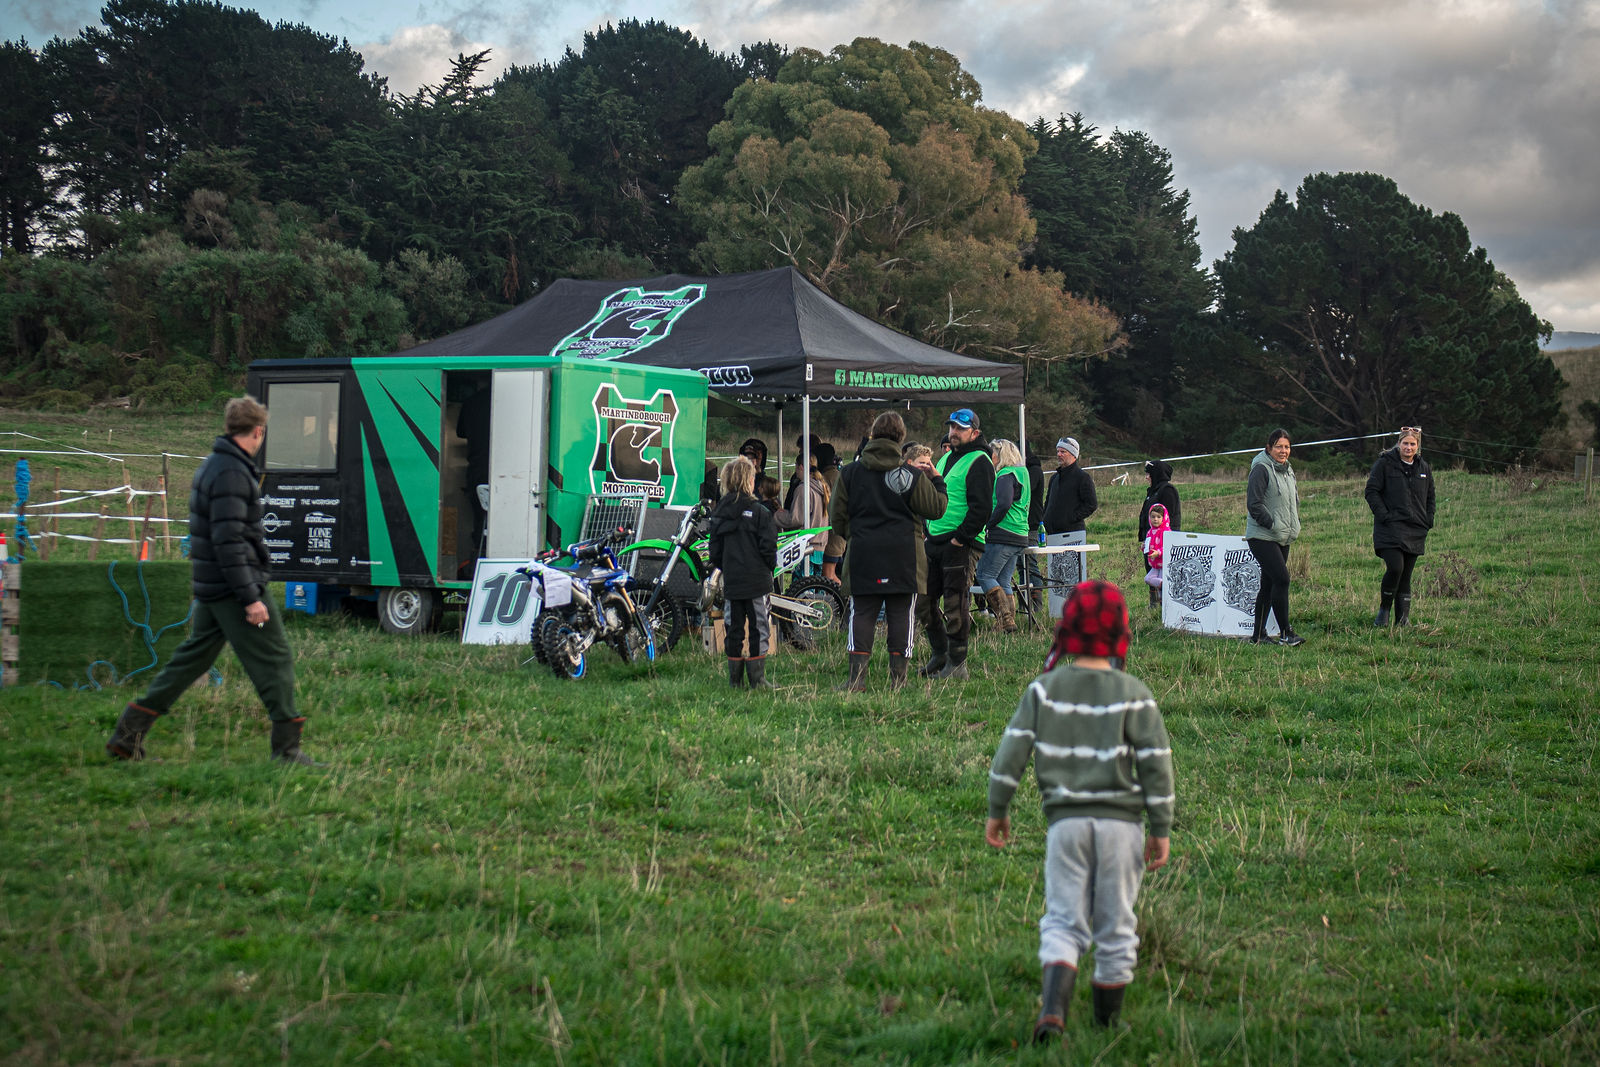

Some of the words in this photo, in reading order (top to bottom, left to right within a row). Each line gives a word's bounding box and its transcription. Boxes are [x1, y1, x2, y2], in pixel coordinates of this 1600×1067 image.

[849, 370, 1000, 392] MARTINBOROUGHMX
[601, 407, 671, 423] MARTINBOROUGH
[602, 482, 665, 498] MOTORCYCLE
[308, 527, 333, 538] LONE
[307, 538, 332, 549] STAR
[782, 543, 801, 568] 35
[1170, 544, 1216, 562] HOLESHOT
[479, 572, 533, 626] 10
[1181, 615, 1201, 624] VISUAL
